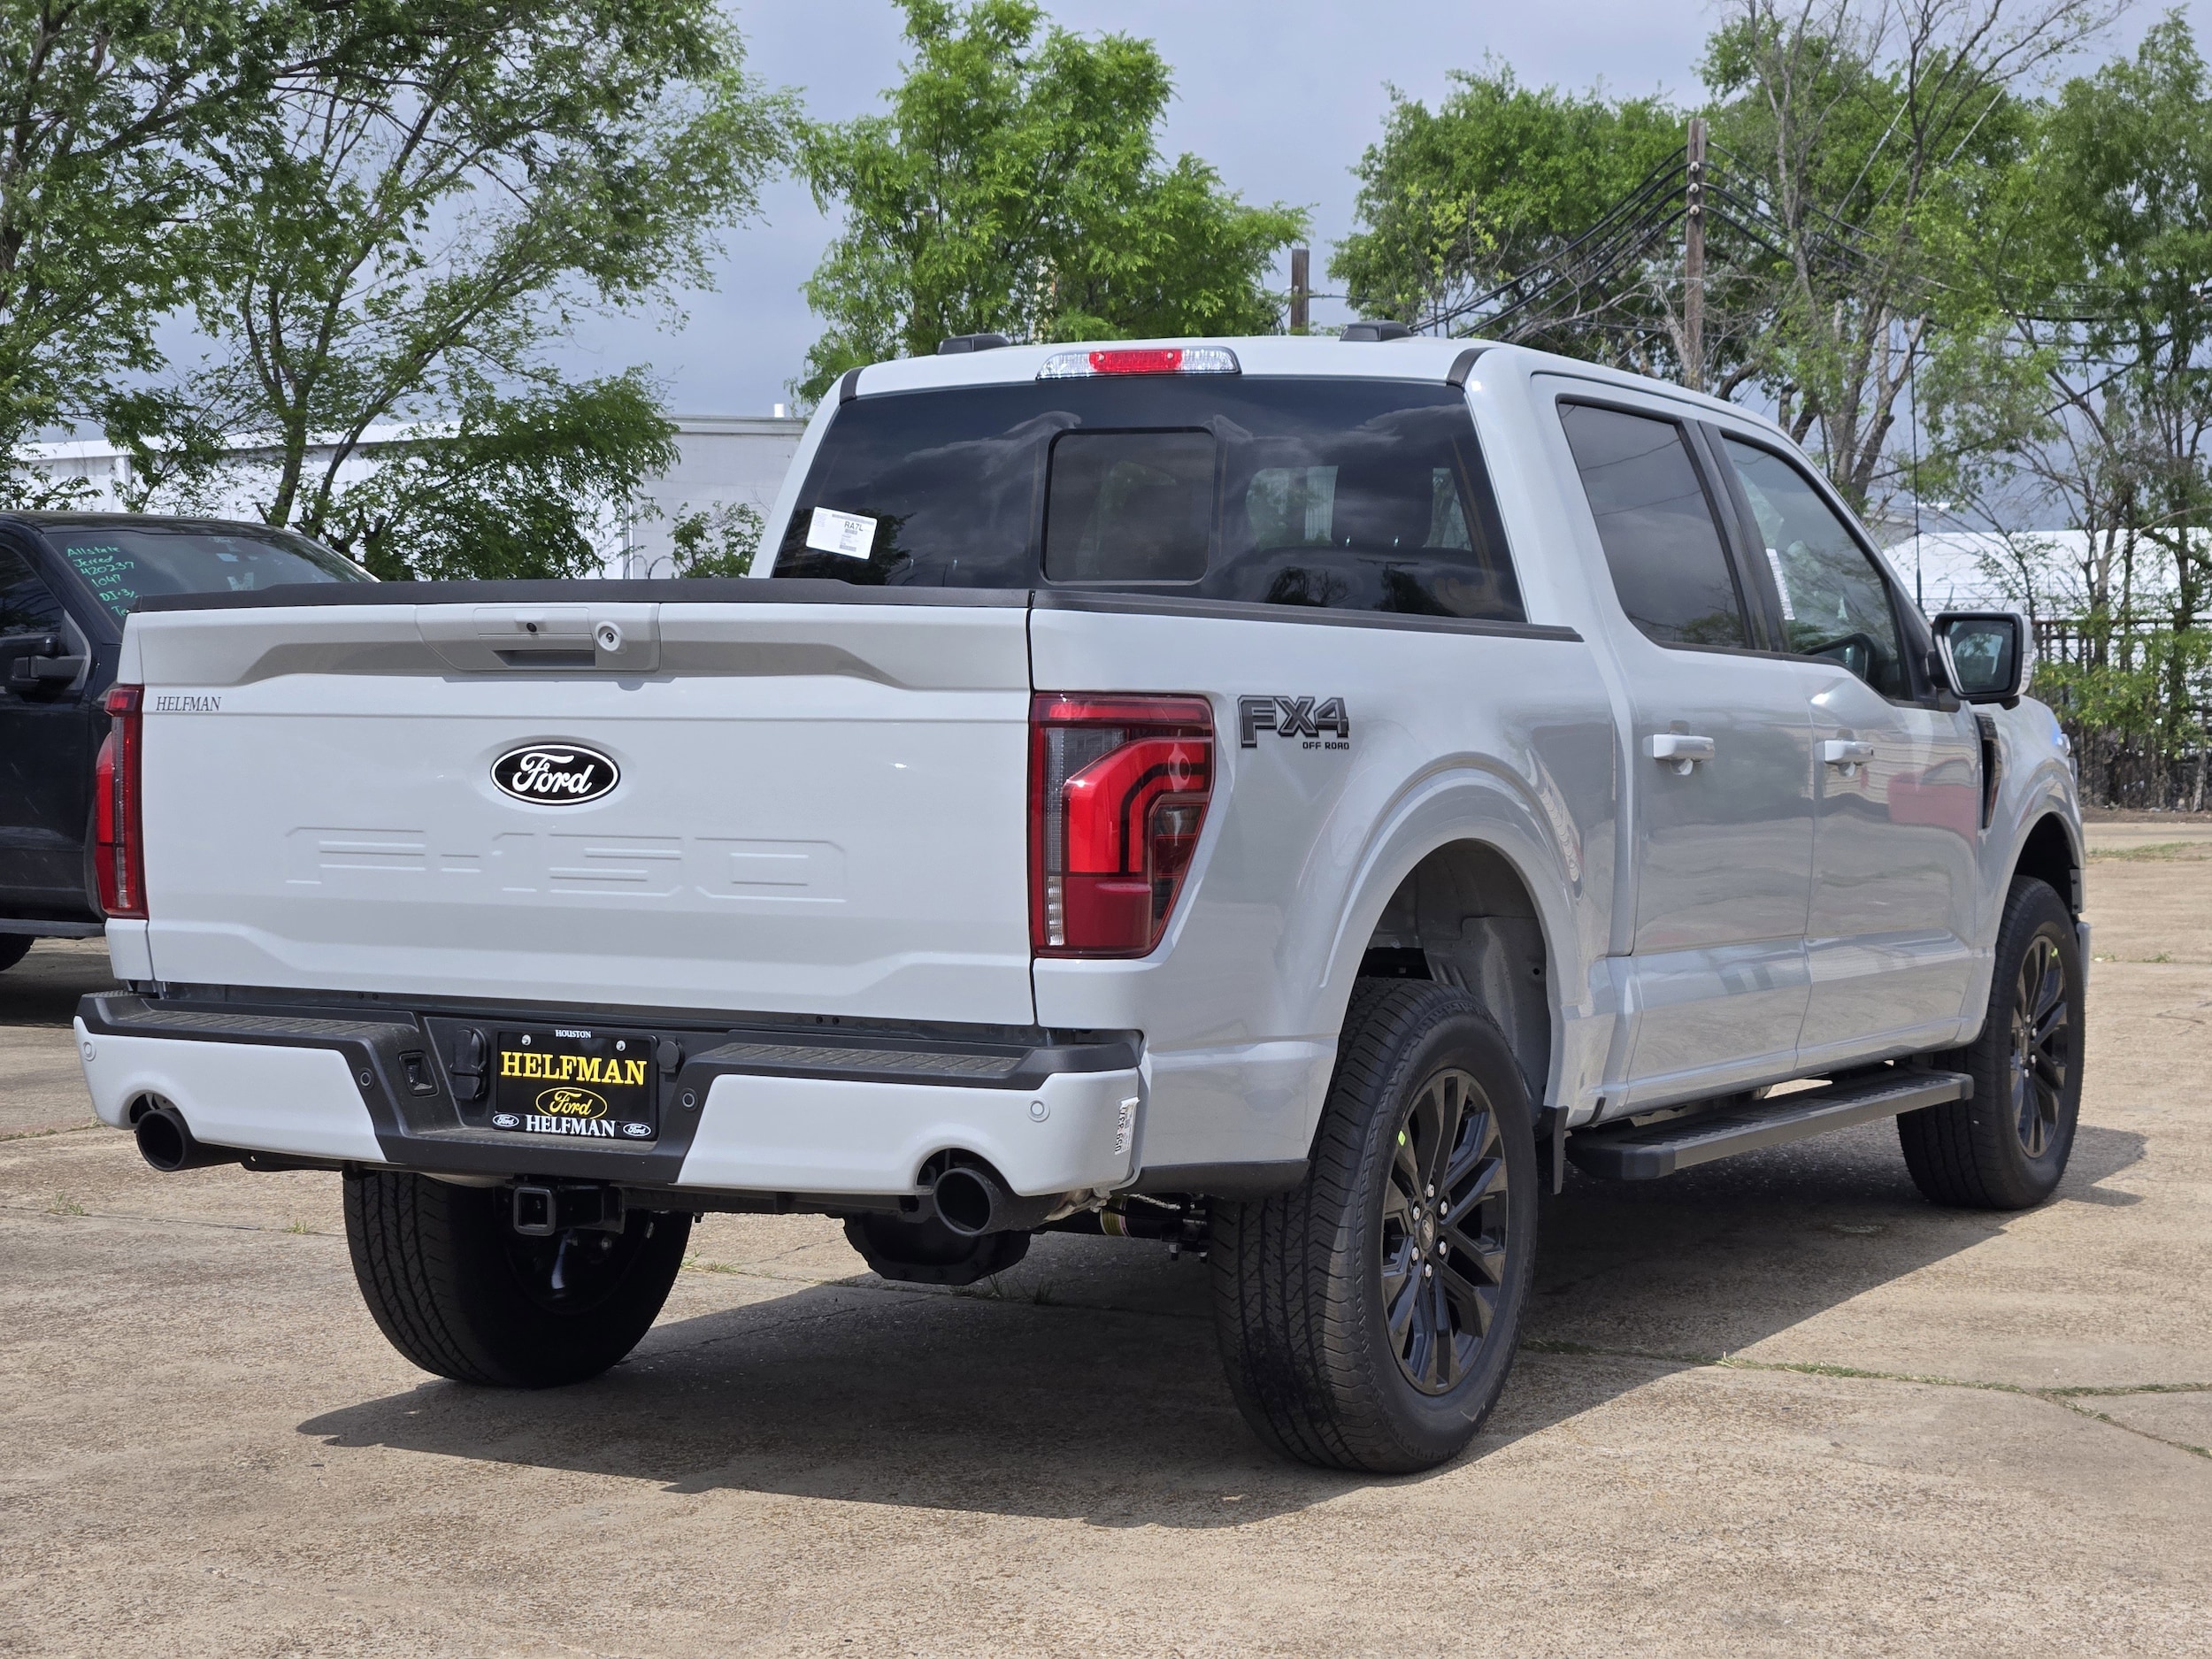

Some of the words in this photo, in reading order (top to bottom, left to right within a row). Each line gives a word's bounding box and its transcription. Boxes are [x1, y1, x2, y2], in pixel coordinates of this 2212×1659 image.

[844, 520, 864, 532] RA7L
[81, 561, 134, 575] 420237
[156, 696, 221, 711] HELFMAN
[1237, 695, 1349, 749] FX4
[1325, 741, 1350, 750] ROAD
[512, 753, 595, 795] Ford
[555, 1029, 592, 1039] HOUSTON
[500, 1051, 647, 1086] HELFMAN
[549, 1090, 594, 1116] Ford
[526, 1115, 616, 1137] HELFMAN
